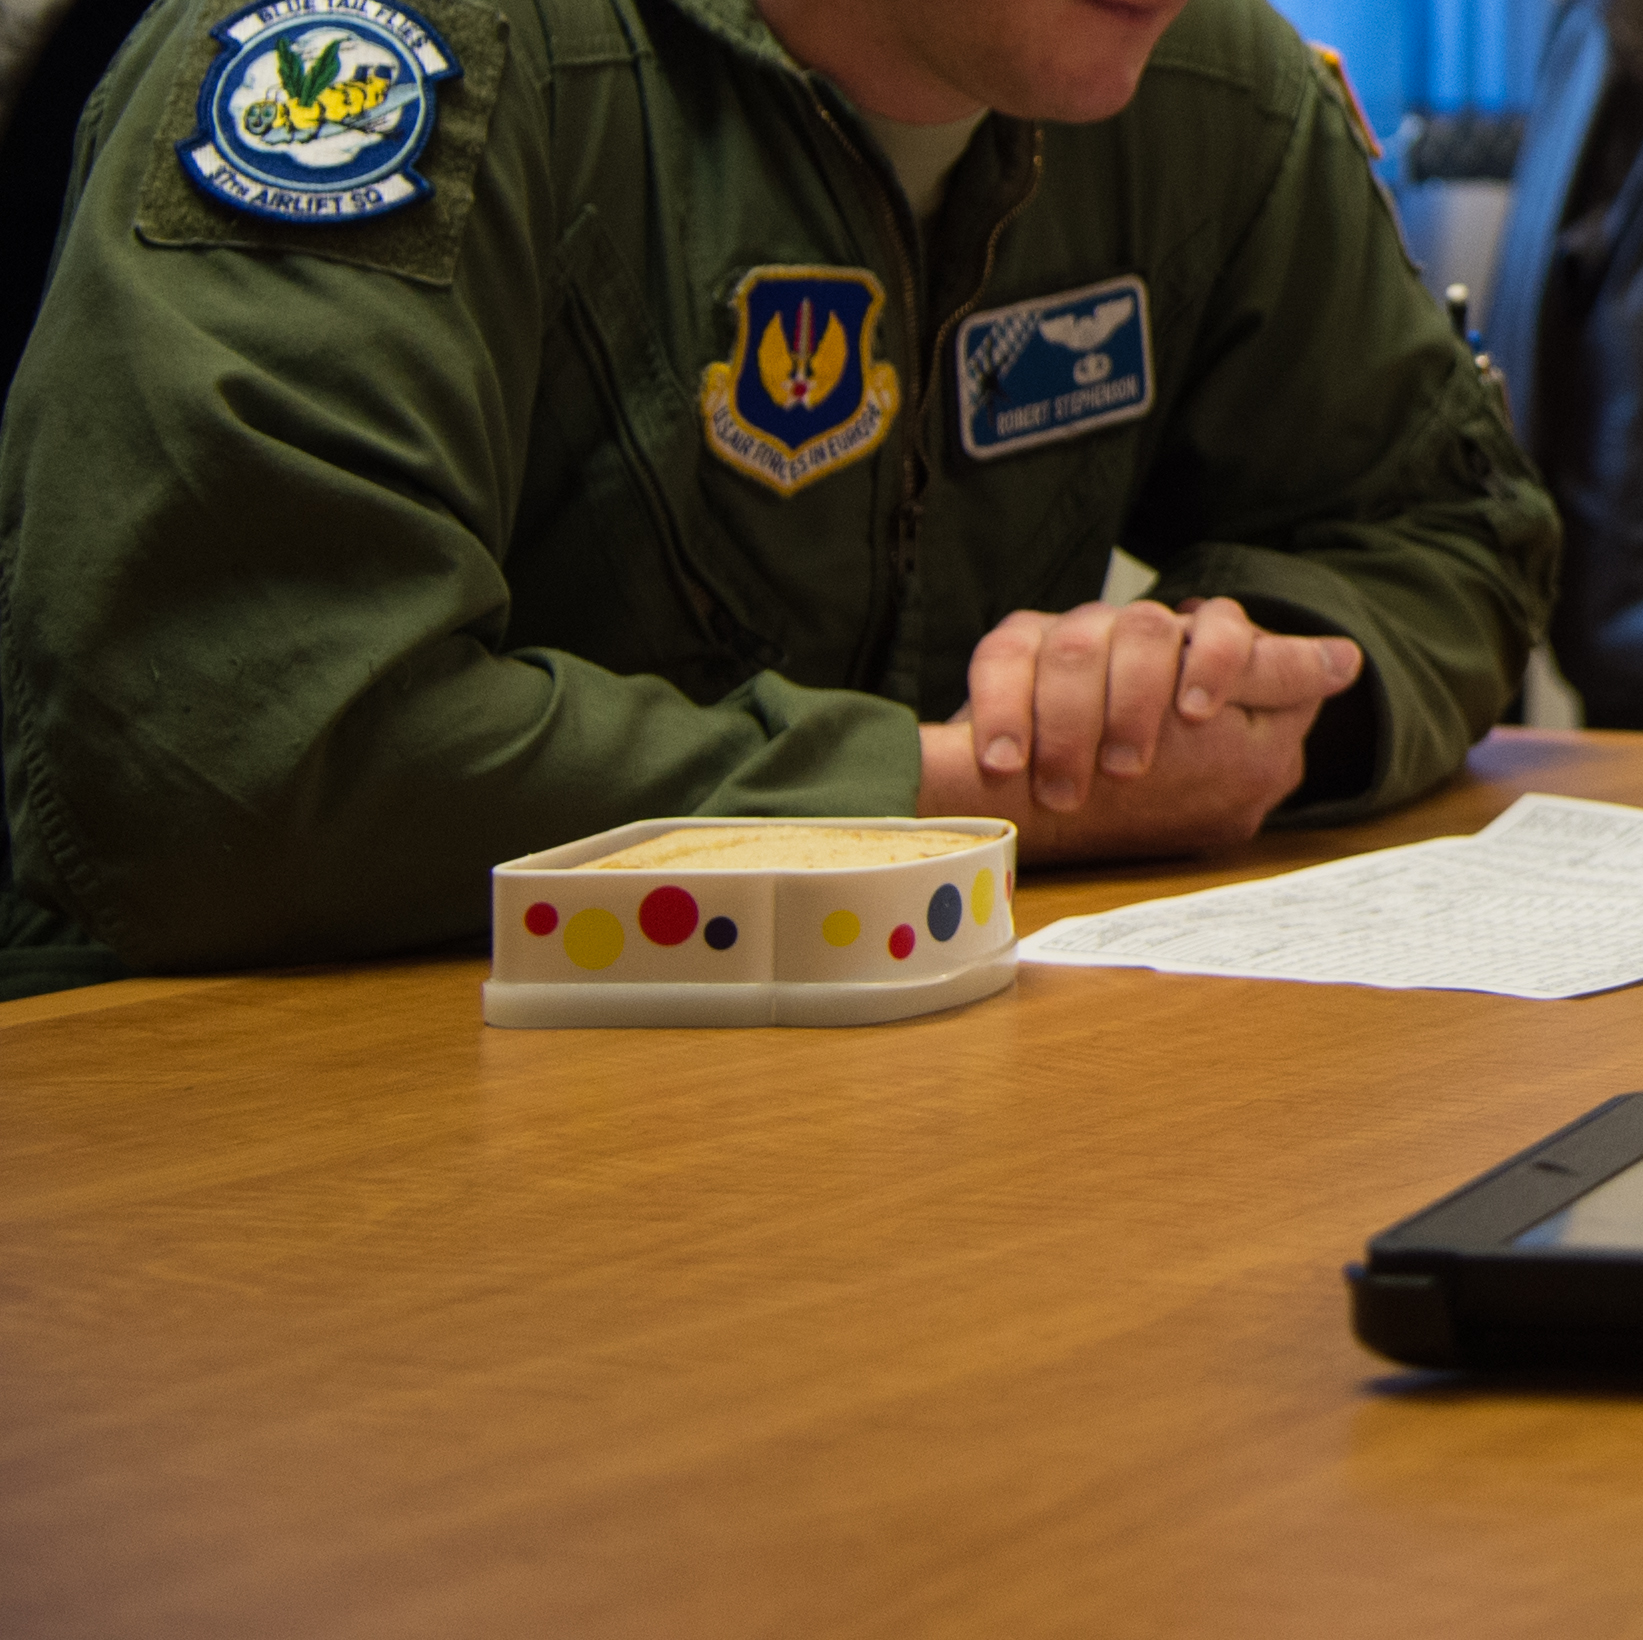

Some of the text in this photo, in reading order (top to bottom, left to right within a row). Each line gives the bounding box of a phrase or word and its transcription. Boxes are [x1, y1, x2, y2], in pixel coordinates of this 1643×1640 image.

[375, 2, 428, 48] FLIES
[251, 188, 344, 214] AIRLIFT
[350, 187, 385, 210] SQ
[995, 373, 1140, 437] ROBERT STEPHENSON
[732, 431, 755, 456] AIR
[809, 445, 826, 465] IN
